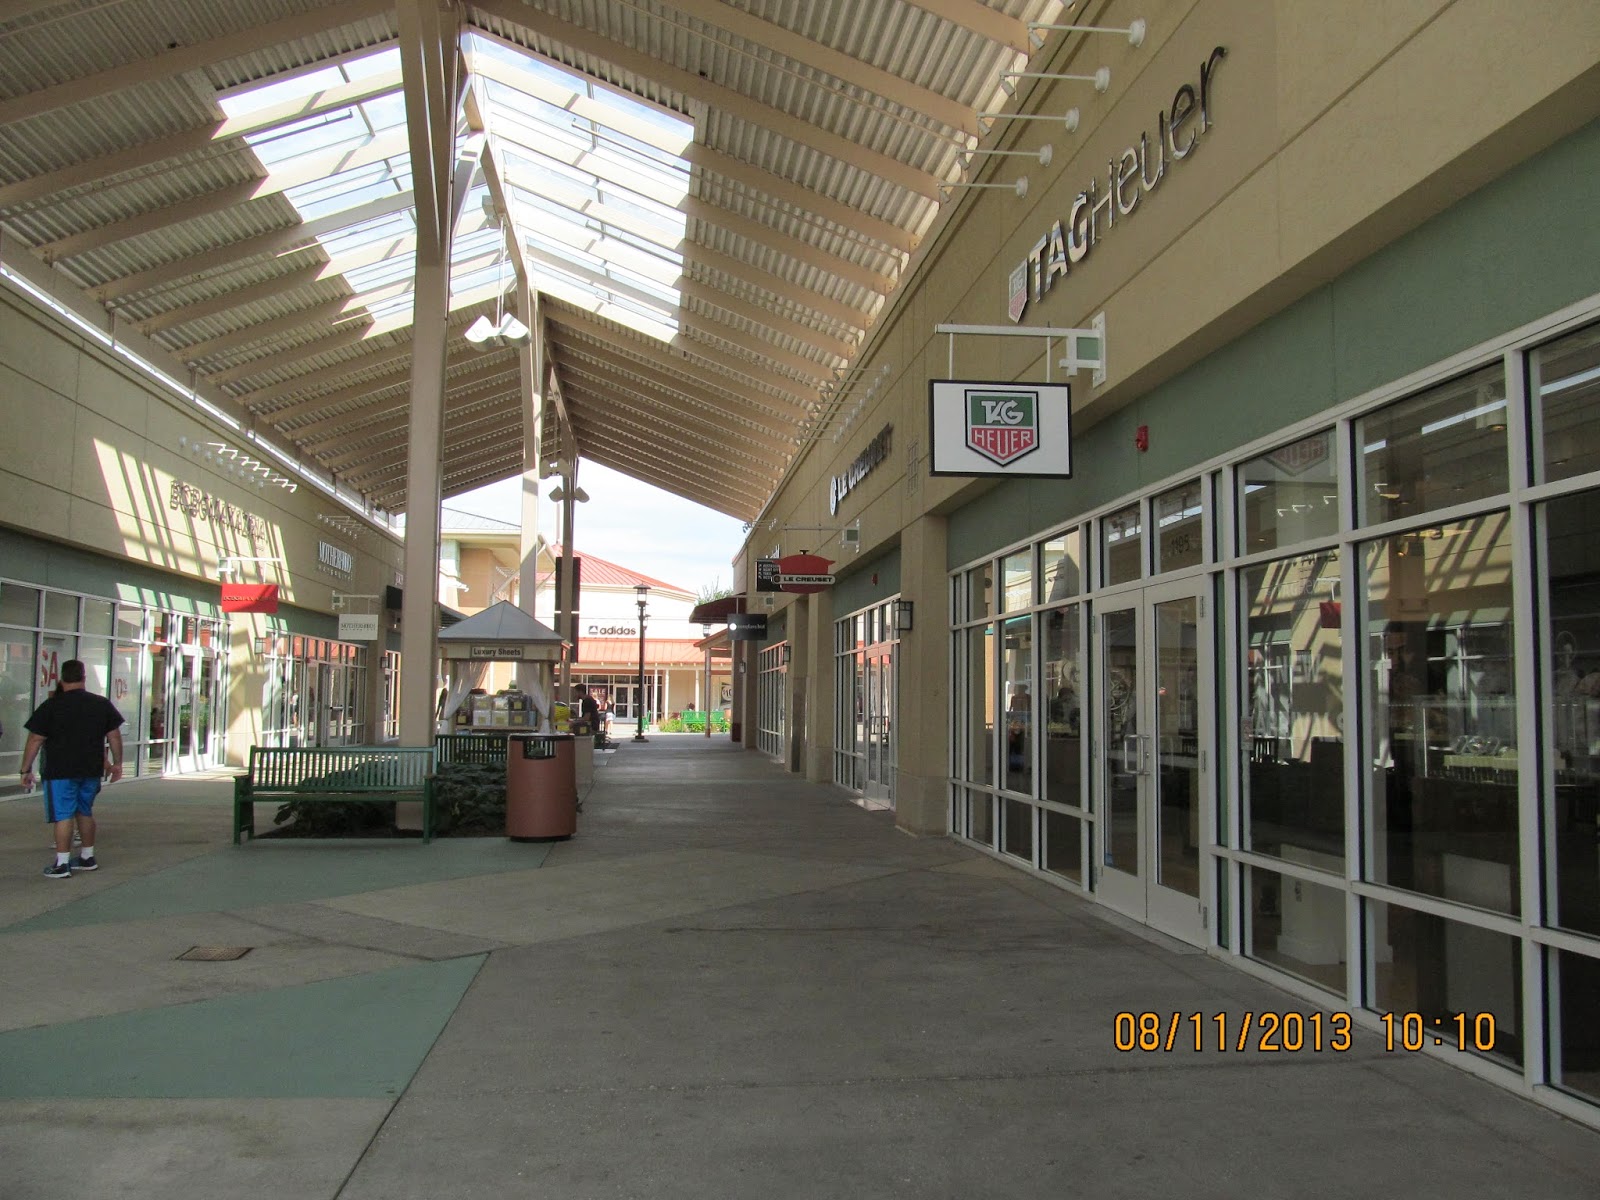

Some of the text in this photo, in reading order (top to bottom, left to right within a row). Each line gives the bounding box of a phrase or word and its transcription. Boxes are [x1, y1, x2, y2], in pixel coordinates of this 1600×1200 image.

[981, 399, 1024, 425] TAG
[974, 429, 1031, 458] HEUER
[783, 575, 834, 584] LE CREUSET
[599, 625, 637, 635] adidas
[473, 647, 521, 657] Luxury Sheets
